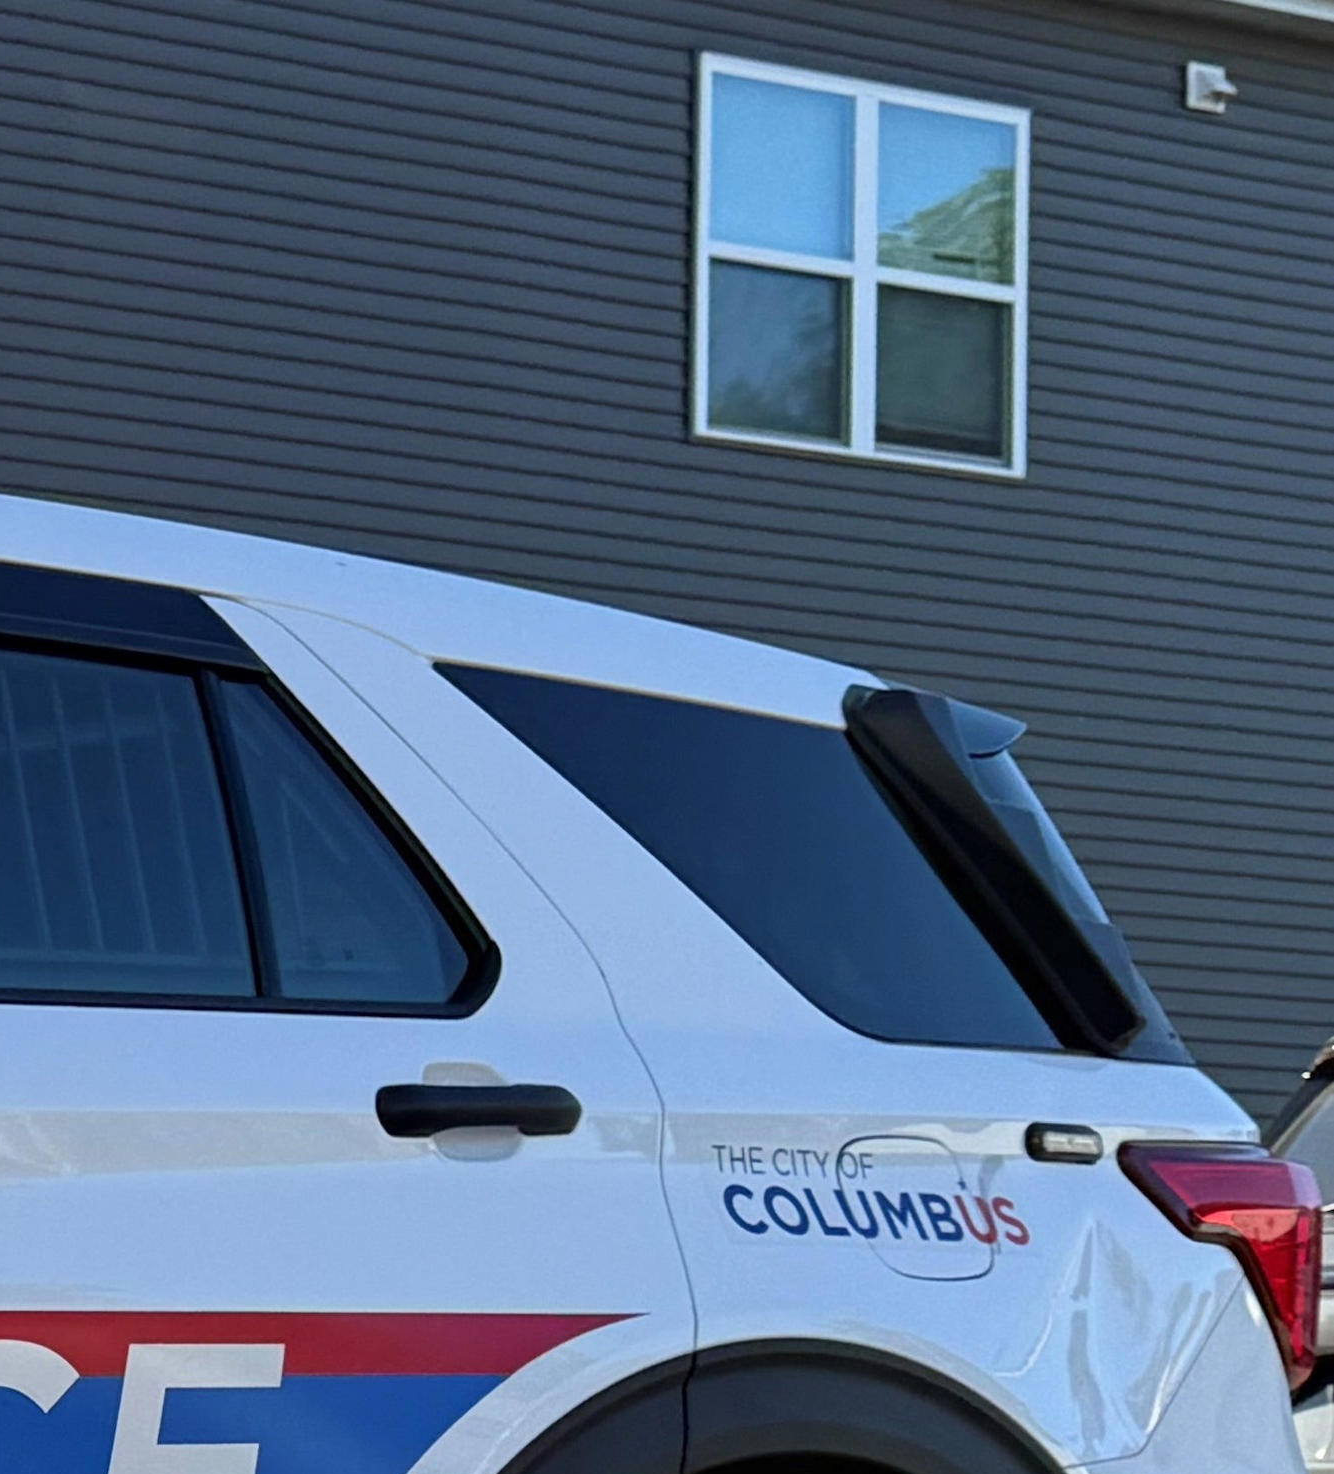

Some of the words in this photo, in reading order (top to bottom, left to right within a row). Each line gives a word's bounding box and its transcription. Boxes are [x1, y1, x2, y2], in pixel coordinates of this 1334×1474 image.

[711, 1144, 765, 1175] THE
[772, 1148, 829, 1178] CITY
[839, 1151, 874, 1179] OF
[723, 1184, 1030, 1246] COLUMBUS
